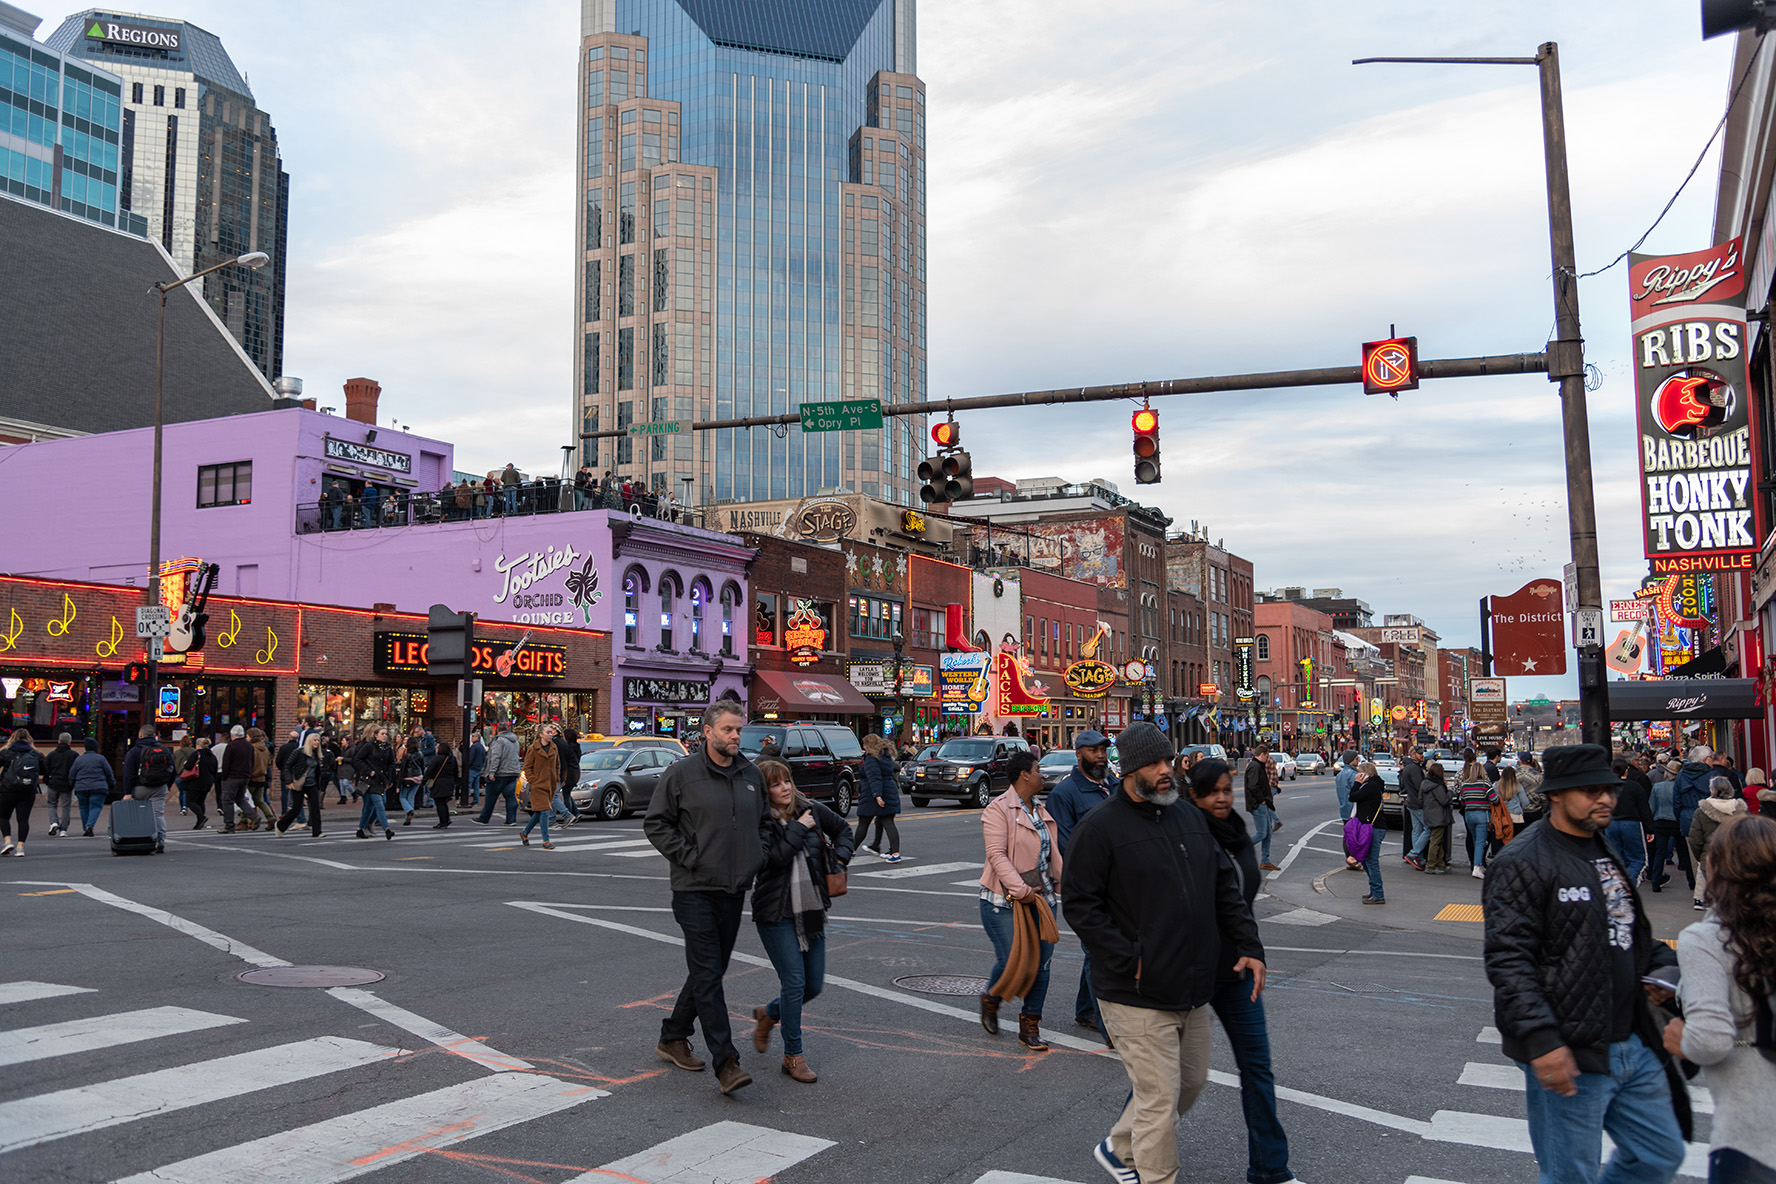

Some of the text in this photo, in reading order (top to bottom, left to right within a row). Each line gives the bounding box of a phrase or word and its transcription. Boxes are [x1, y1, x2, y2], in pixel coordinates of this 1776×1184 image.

[1633, 243, 1739, 301] Rippy's
[1641, 322, 1740, 368] RIBS
[640, 421, 680, 435] PARKING
[818, 417, 861, 430] Opry Pl
[1643, 425, 1750, 473] BARBEQUE
[1647, 469, 1750, 514] HONKY
[730, 510, 781, 529] NASHVILLE
[801, 511, 853, 536] STAGE
[1650, 510, 1753, 551] TONK
[1655, 554, 1753, 572] NASHVILLE
[493, 544, 581, 604] Tootsies
[513, 593, 564, 609] ORCHID
[1635, 586, 1664, 599] NASHV
[1682, 578, 1698, 616] ROOM
[1611, 600, 1648, 610] ERNES
[512, 611, 574, 625] LOUNGE
[1493, 611, 1562, 624] The District
[1617, 610, 1648, 620] RECOR
[138, 622, 151, 633] OK
[516, 650, 564, 673] GIFTS
[943, 653, 980, 671] Robert's
[1241, 646, 1249, 689] WHISKEY
[1067, 665, 1114, 687] STAGE
[1000, 658, 1012, 714] JACKS
[1011, 704, 1047, 712] BAR-B-QUE
[1666, 692, 1707, 709] Rippy's
